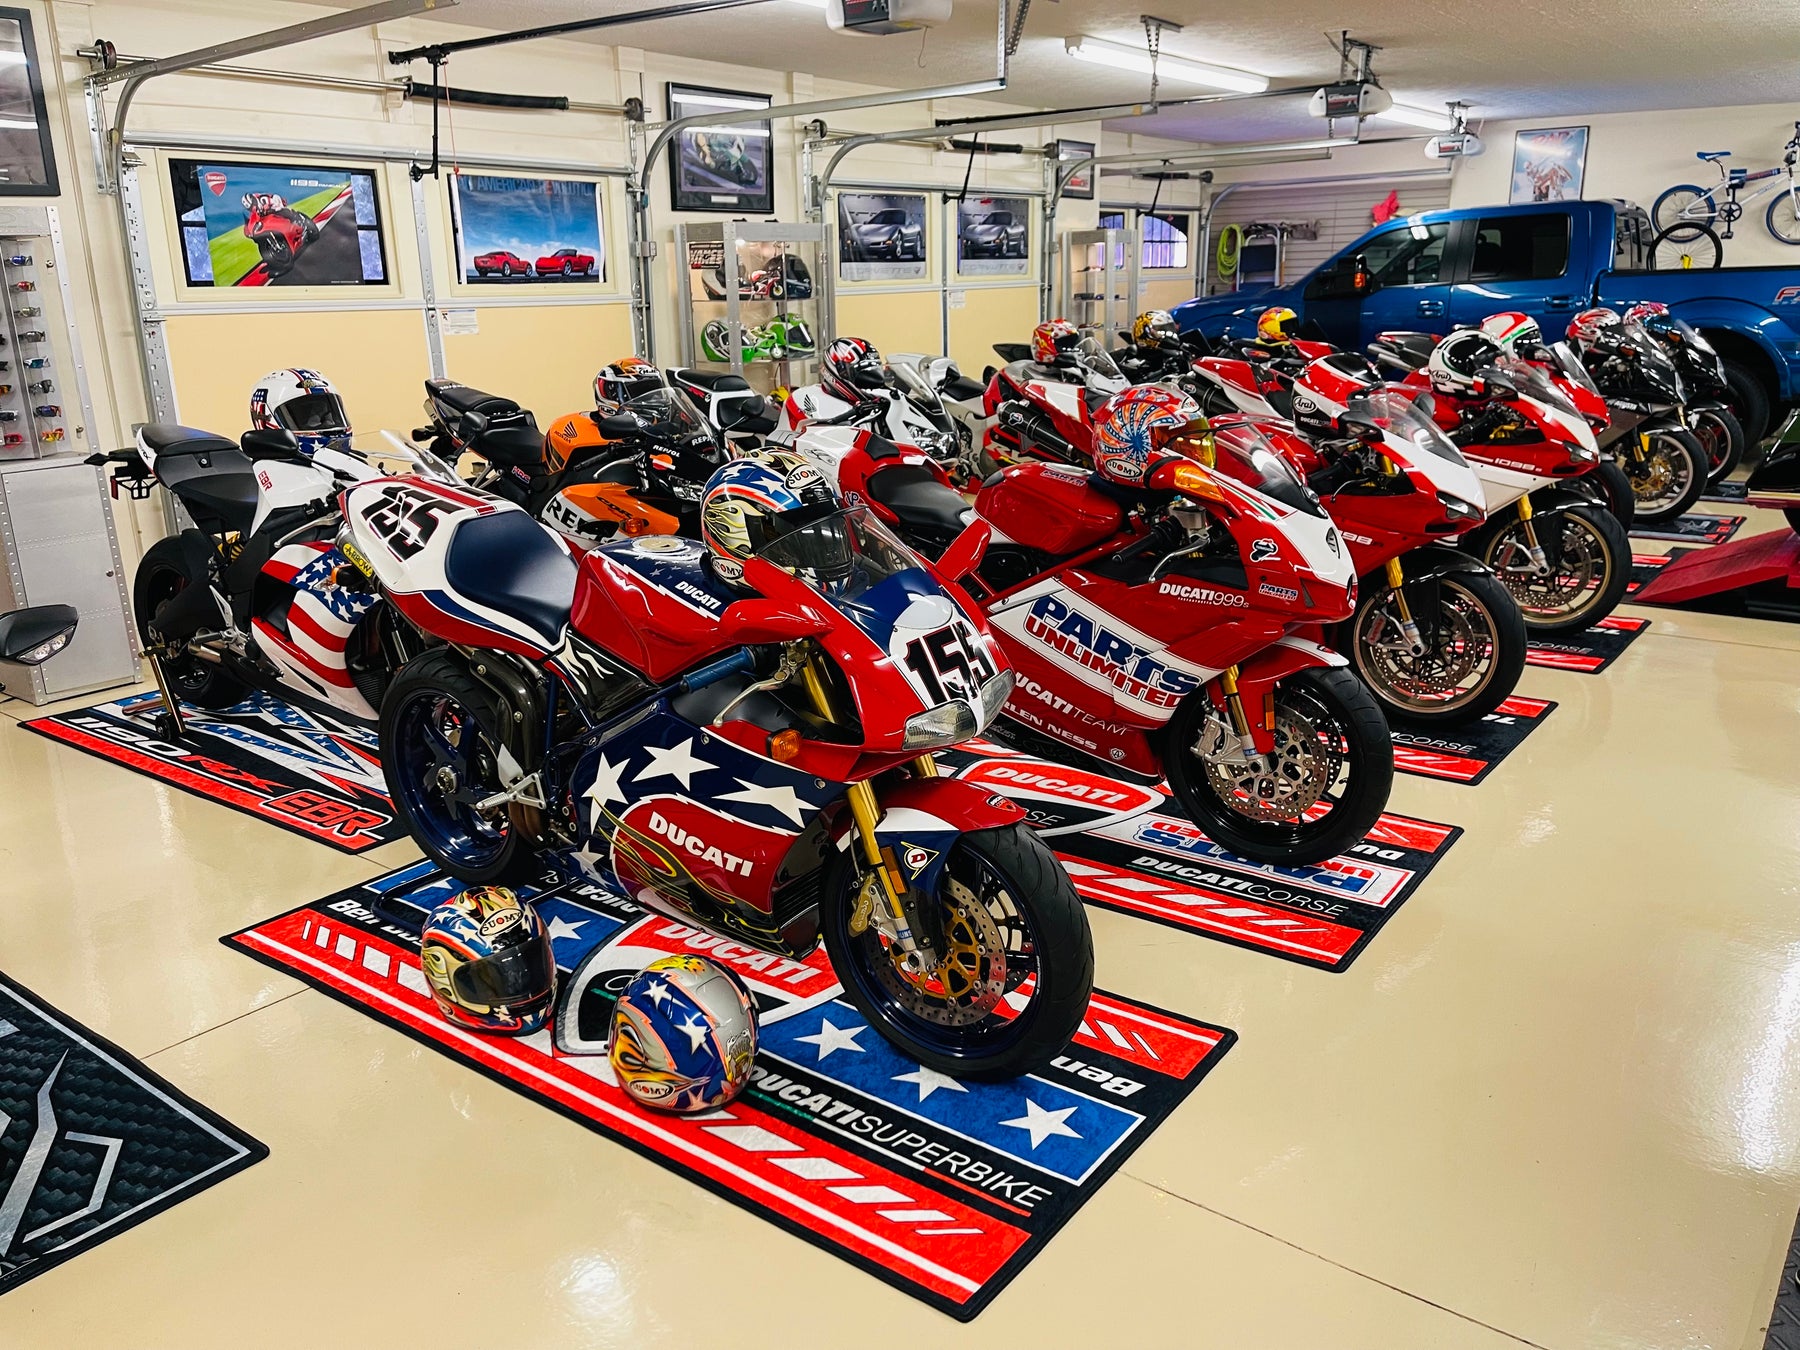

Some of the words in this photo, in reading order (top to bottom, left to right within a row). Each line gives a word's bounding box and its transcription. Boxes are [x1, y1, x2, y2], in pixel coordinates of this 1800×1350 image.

[1294, 399, 1313, 408] Arai
[653, 444, 681, 458] REPSOL
[258, 470, 273, 491] EBR
[675, 581, 722, 610] DUCATI
[1025, 615, 1182, 707] UNLIMITED
[1031, 595, 1201, 694] PARTS
[1015, 672, 1130, 736] UCATITEAM
[1048, 723, 1098, 750] NESS
[984, 767, 1129, 804] DUCATI
[263, 790, 388, 836] EBR
[648, 811, 754, 877] DUCATI
[481, 910, 522, 933] SUOMY
[655, 922, 822, 984] DUCATI
[1050, 1056, 1147, 1097] Ben
